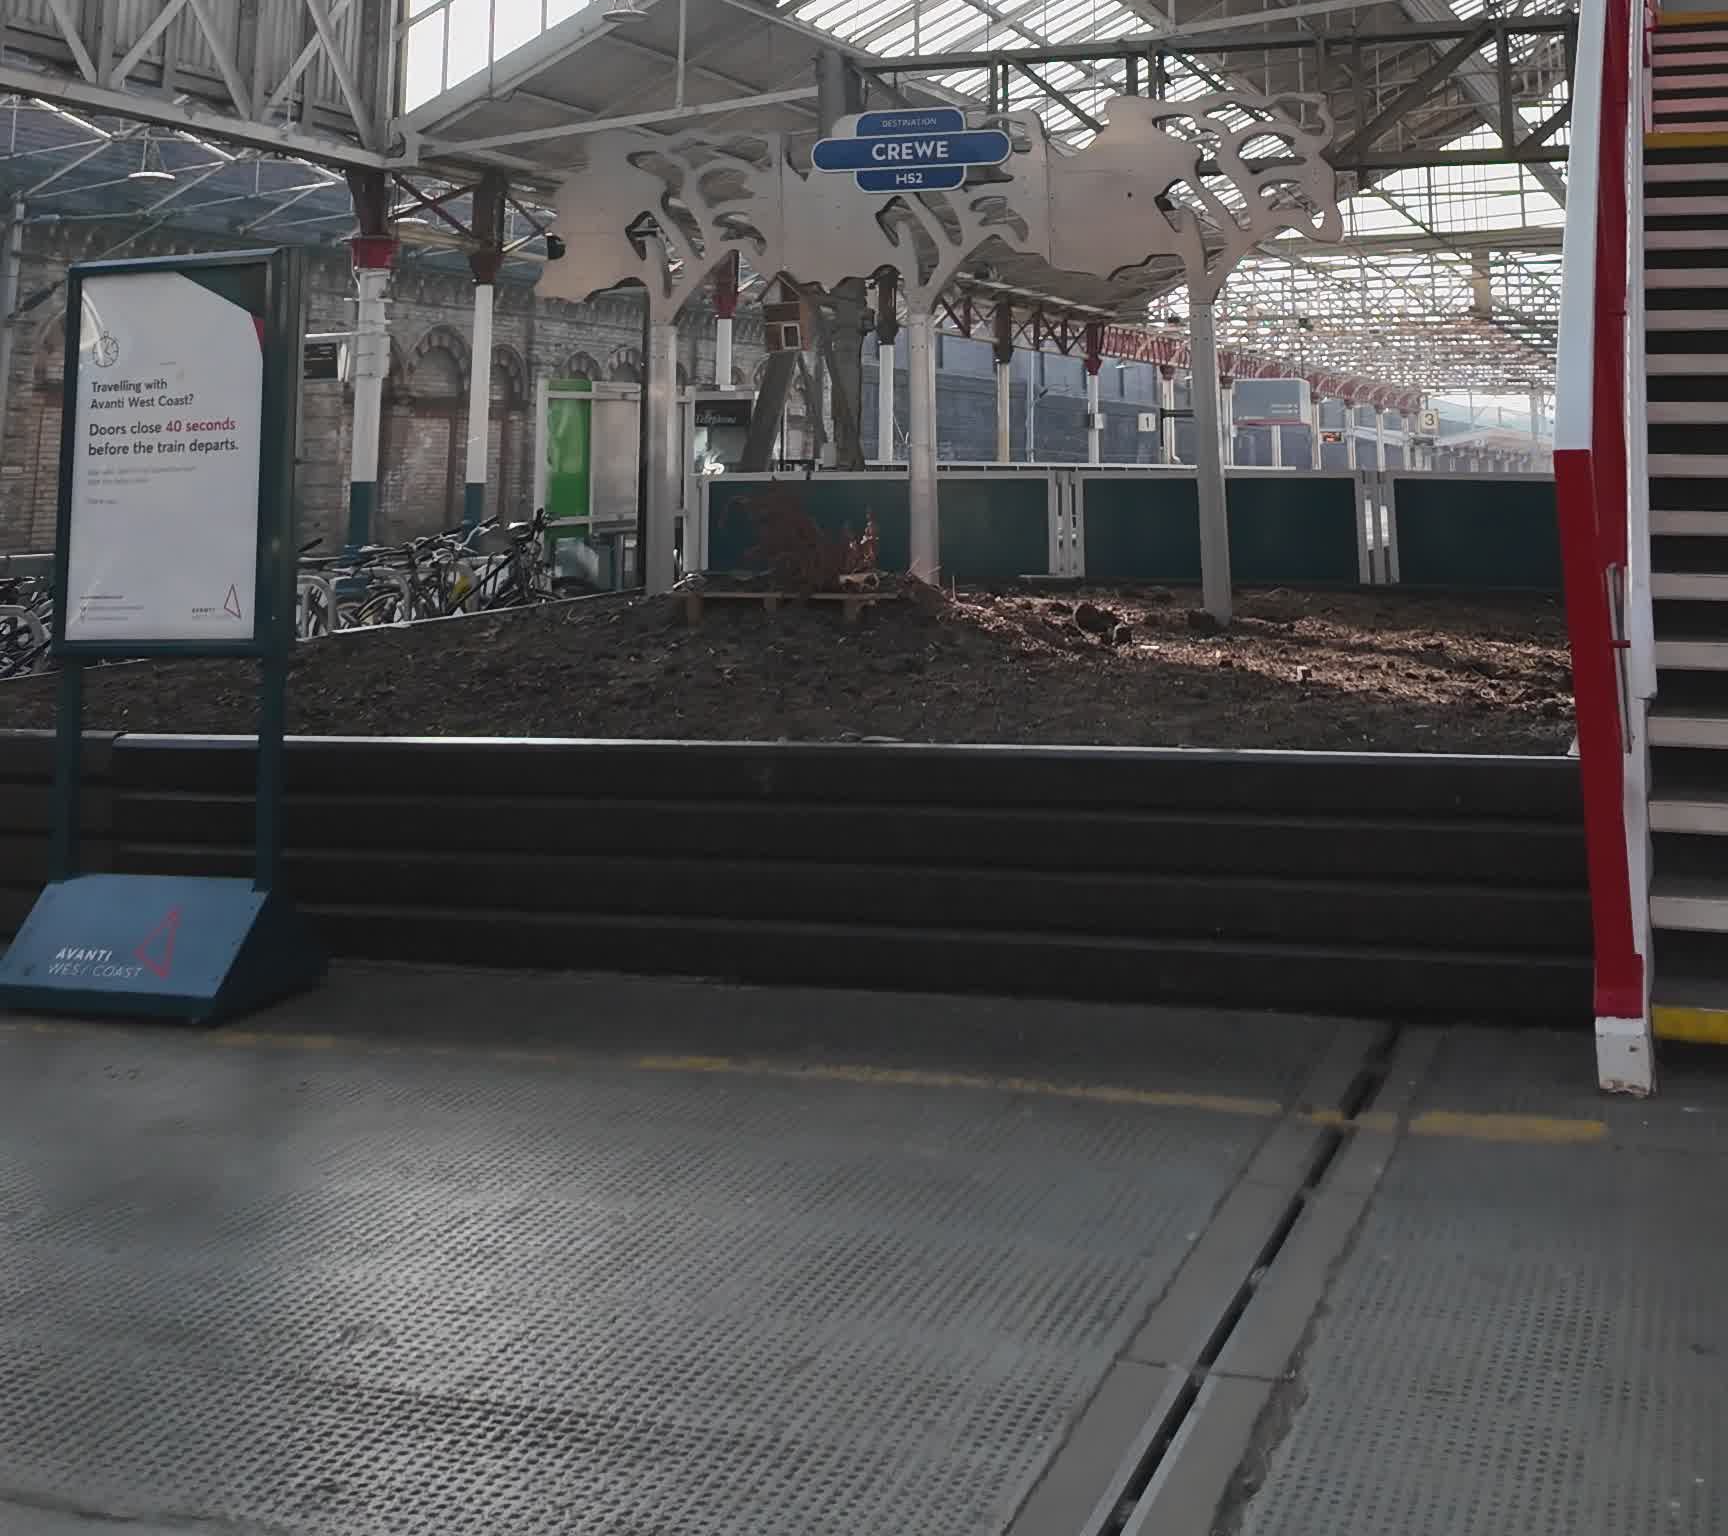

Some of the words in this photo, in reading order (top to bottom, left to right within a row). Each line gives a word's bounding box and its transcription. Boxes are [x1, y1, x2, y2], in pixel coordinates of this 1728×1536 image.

[881, 118, 937, 128] DESTINATION
[871, 141, 949, 161] CREWE
[895, 172, 923, 185] HS2
[91, 379, 142, 394] Travelling
[144, 378, 168, 391] with
[90, 397, 125, 410] Avanti
[128, 396, 155, 408] West
[158, 393, 194, 407] Coast?
[89, 423, 127, 437] Doors
[130, 421, 162, 434] close
[166, 420, 182, 433] 40
[185, 417, 236, 432] seconds
[1425, 413, 1435, 426] 3
[88, 442, 130, 456] before
[133, 440, 154, 454] the
[157, 439, 185, 453] train
[189, 438, 239, 455] departs.
[56, 948, 112, 962] AVANTI
[49, 963, 90, 977] WEST
[93, 965, 143, 978] COAST
